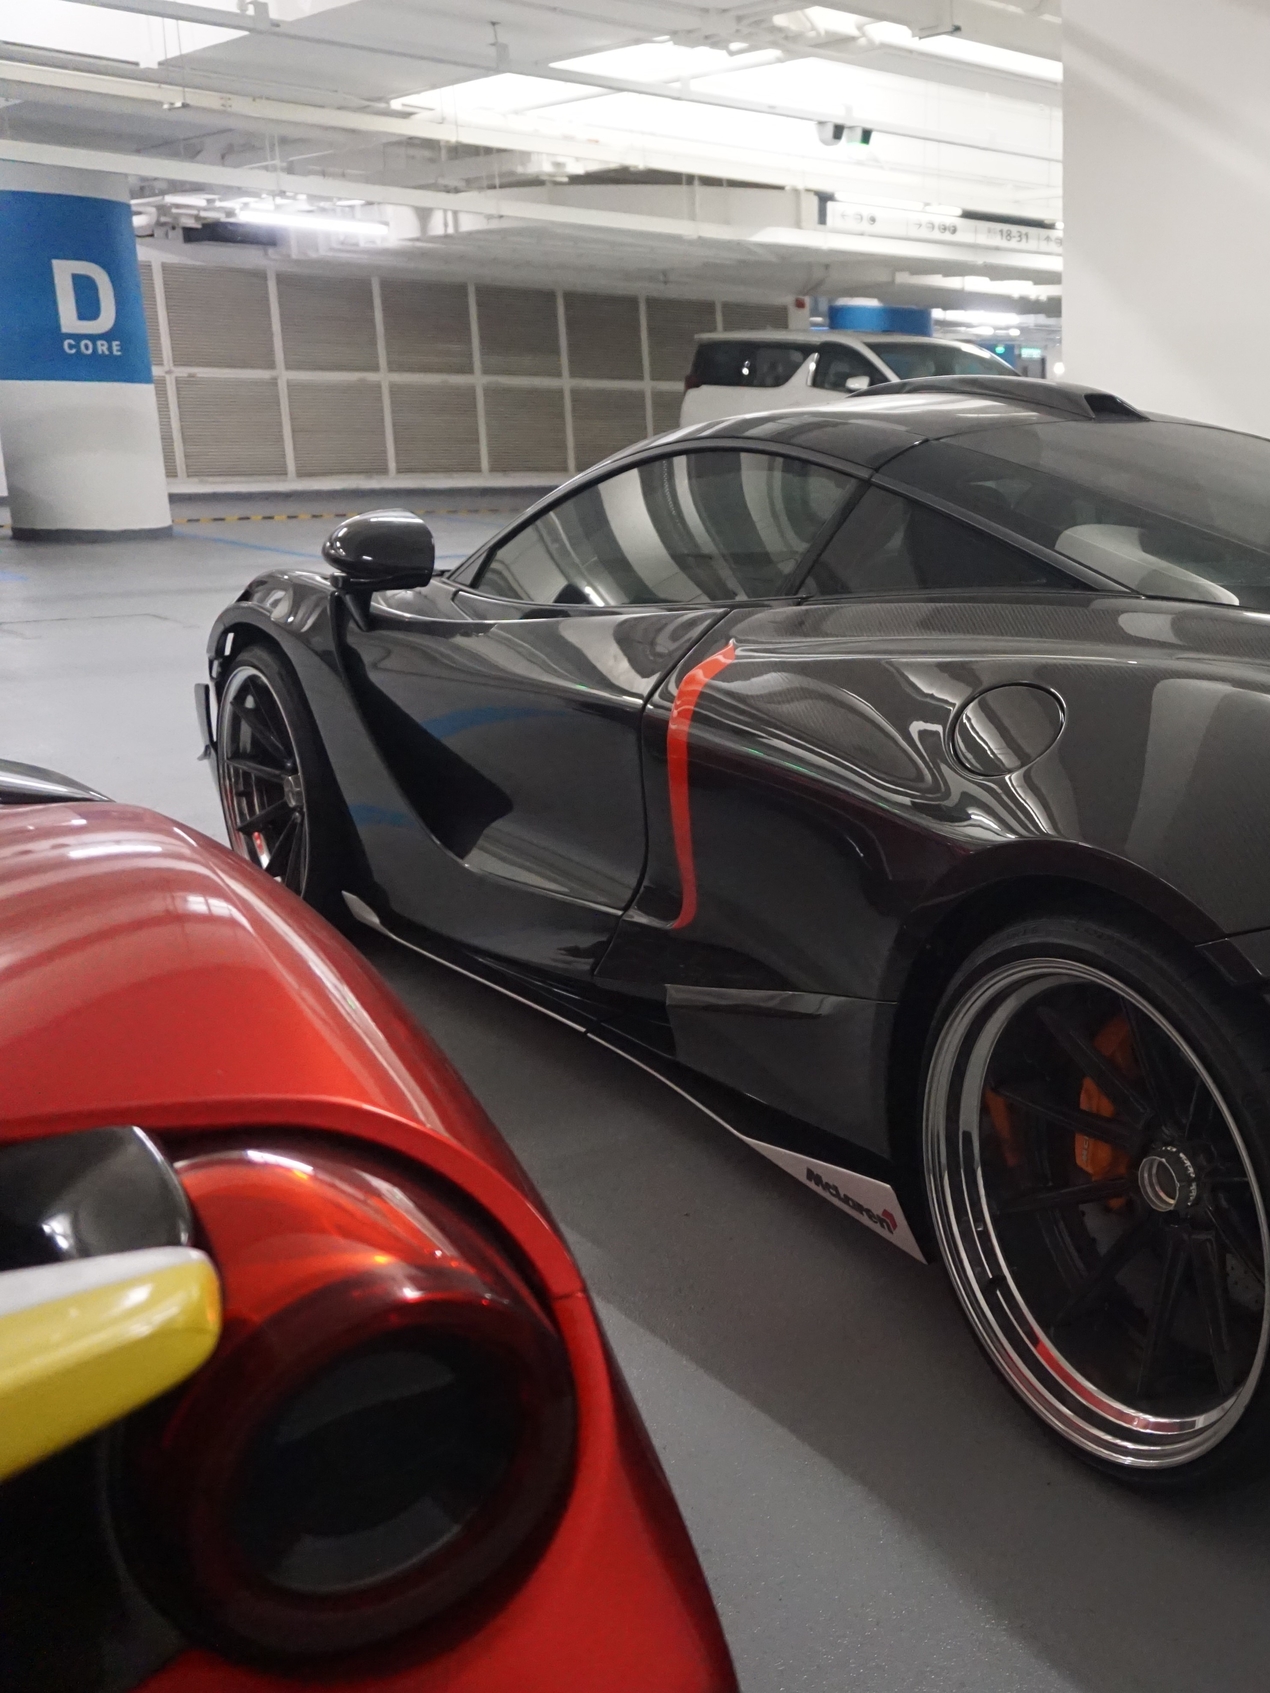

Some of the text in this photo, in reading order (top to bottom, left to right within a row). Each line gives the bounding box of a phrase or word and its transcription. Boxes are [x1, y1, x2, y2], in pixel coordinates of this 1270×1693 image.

[998, 228, 1030, 244] 18-31
[51, 259, 116, 334] D
[63, 339, 122, 355] CORE
